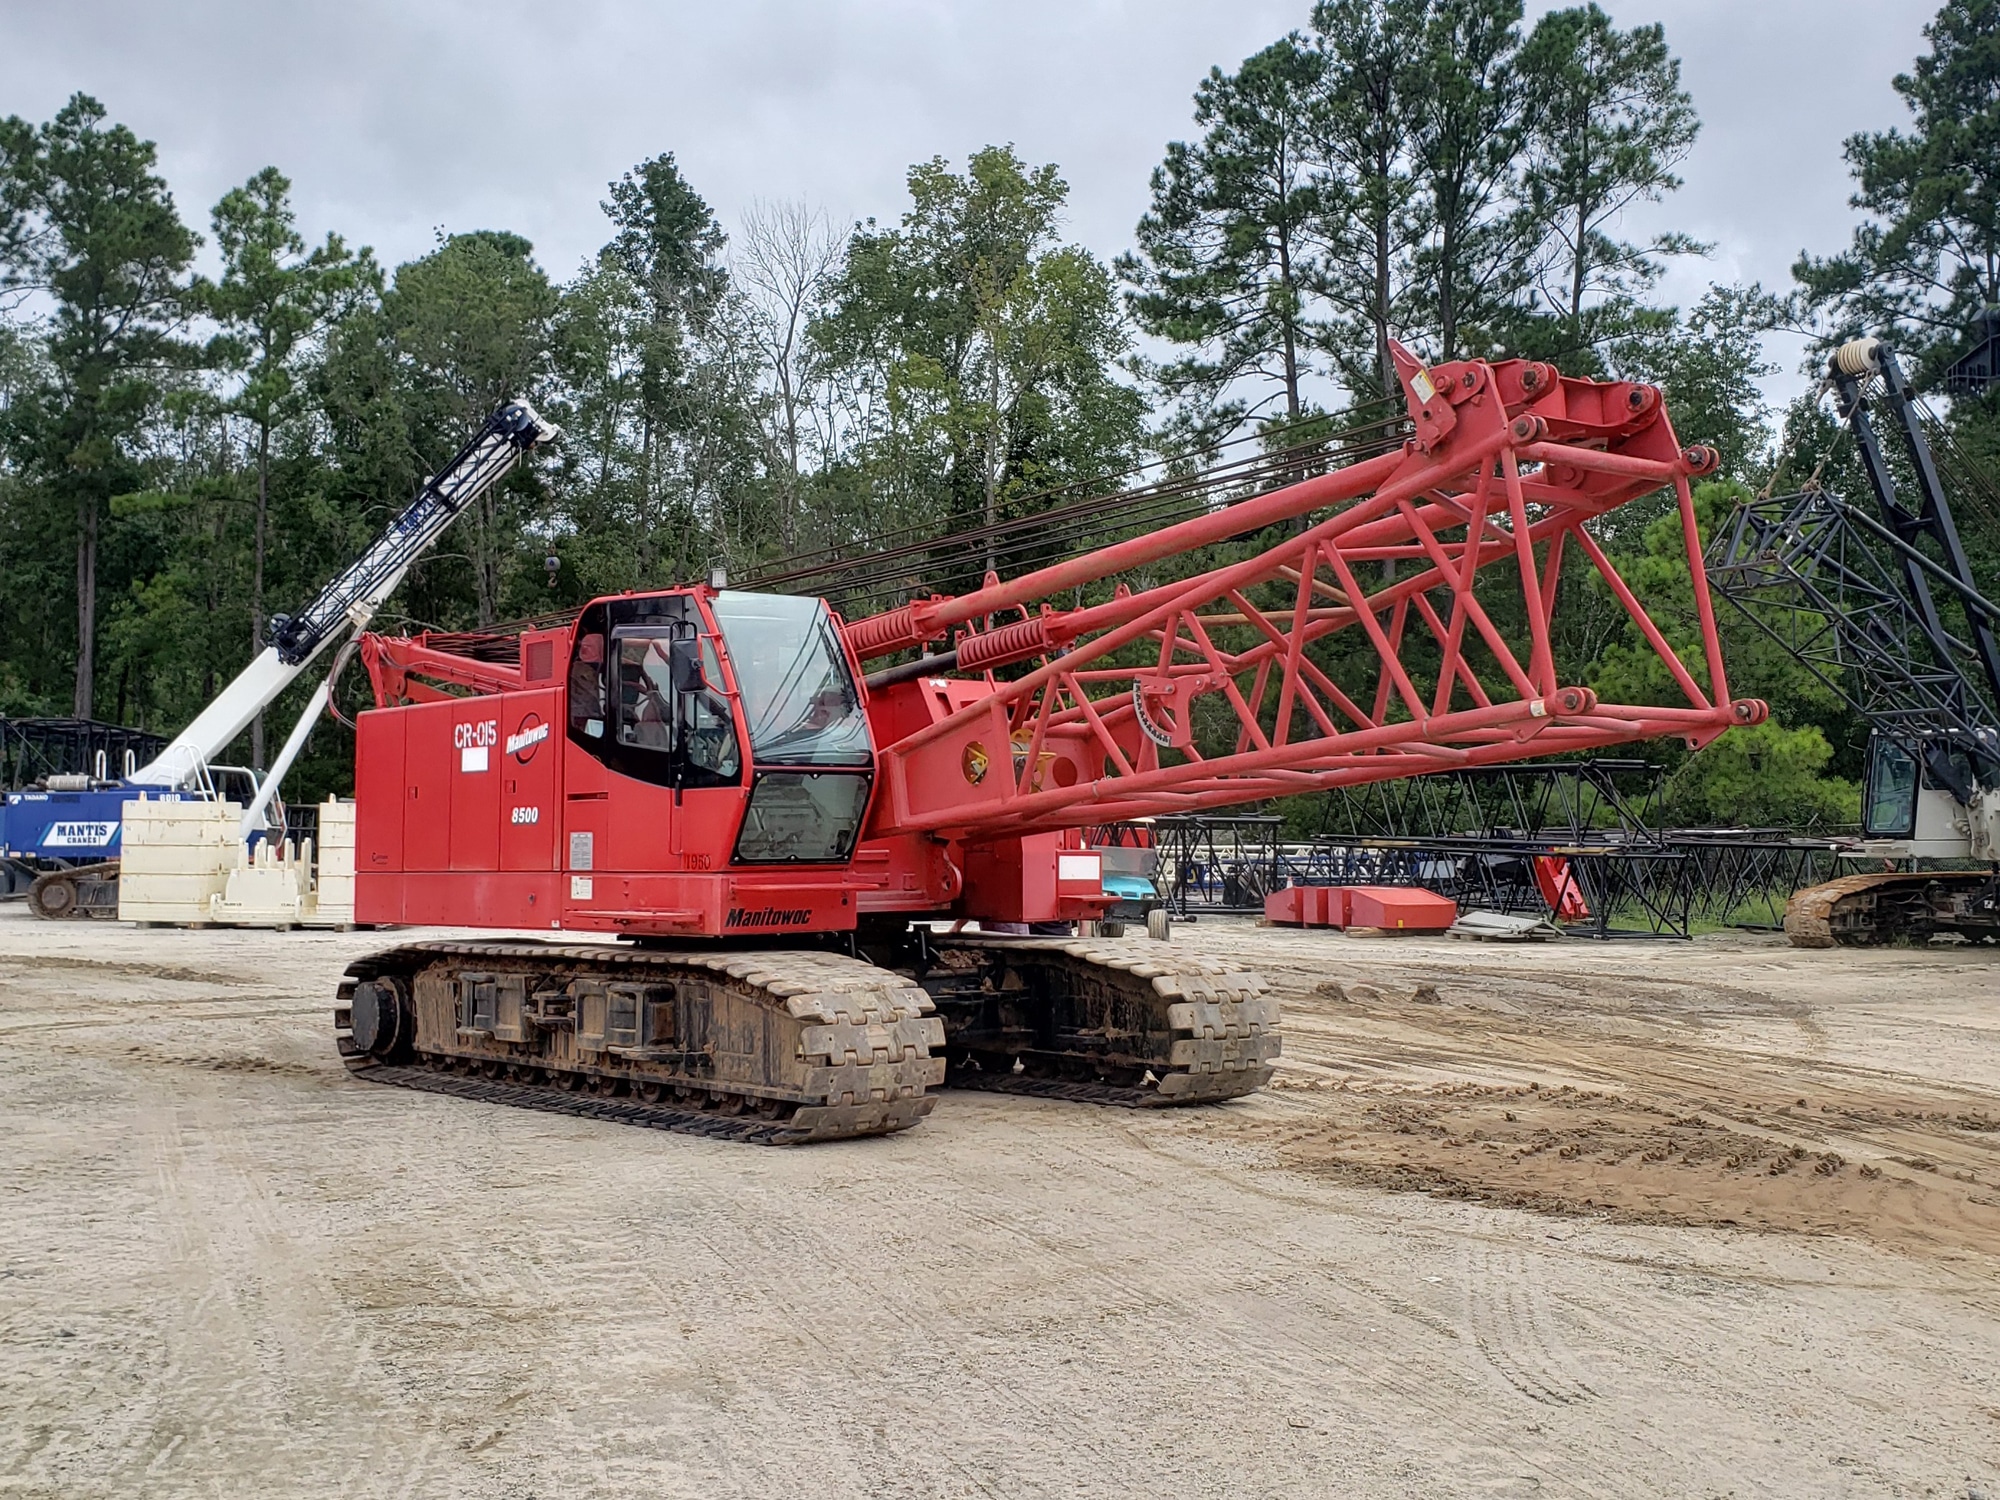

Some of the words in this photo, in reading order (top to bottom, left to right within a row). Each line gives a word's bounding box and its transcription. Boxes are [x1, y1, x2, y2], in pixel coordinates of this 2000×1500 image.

[454, 720, 497, 749] CR-015
[505, 722, 549, 755] Manitowoc
[511, 806, 539, 824] 8500
[57, 824, 108, 837] MANTIS
[724, 906, 813, 928] Manitowoc
